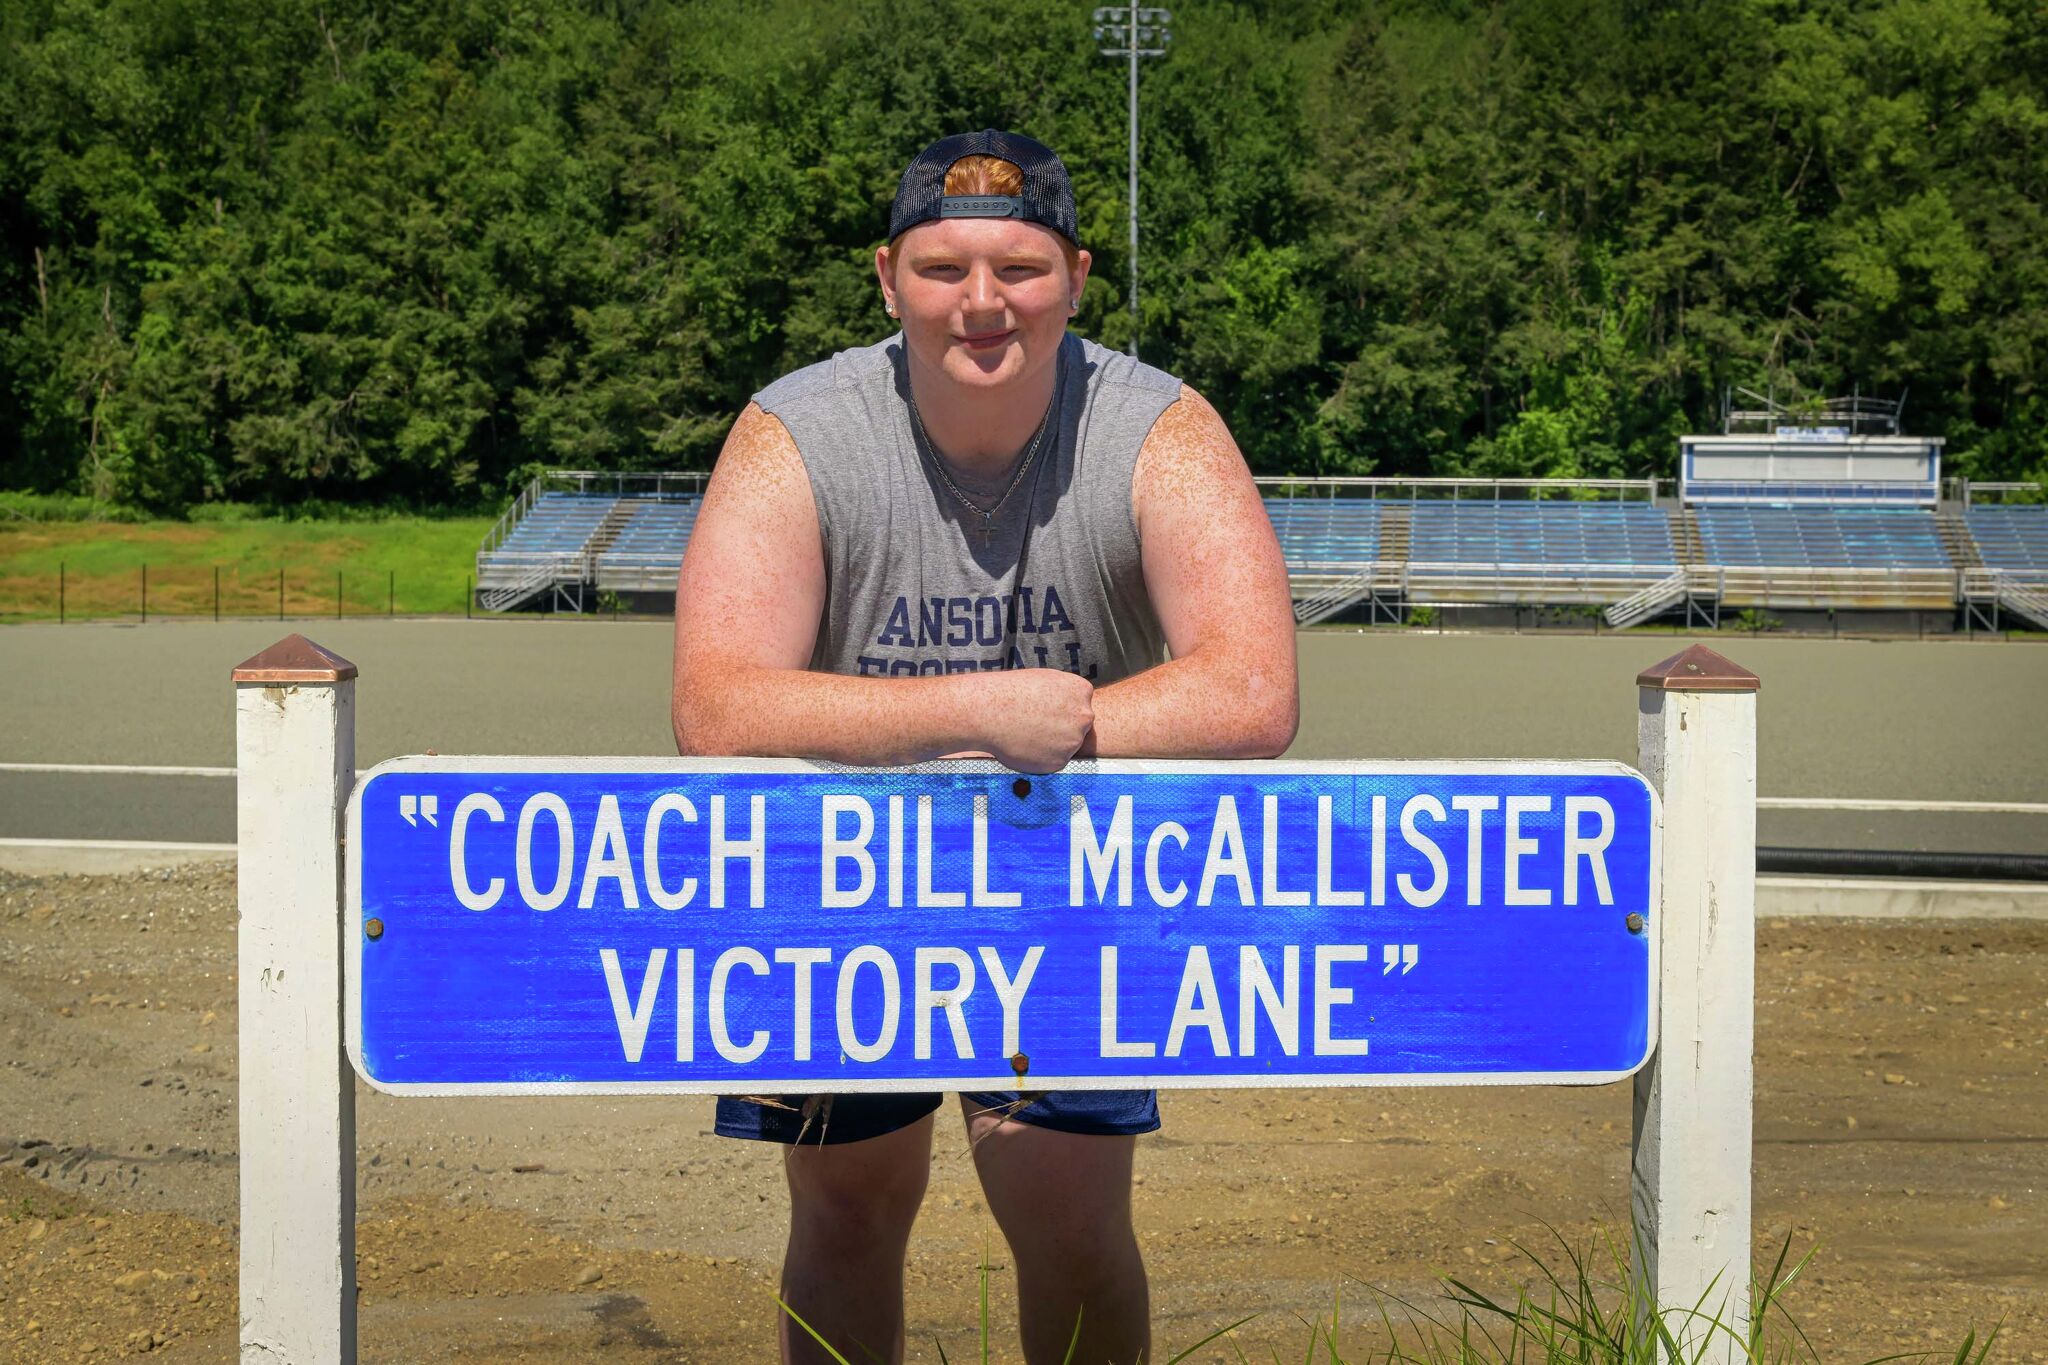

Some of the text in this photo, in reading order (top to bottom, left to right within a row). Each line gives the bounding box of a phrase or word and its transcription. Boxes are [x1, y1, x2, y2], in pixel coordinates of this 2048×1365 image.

[821, 794, 1022, 908] BILL
[1069, 794, 1616, 908] McALLISTER
[599, 944, 1045, 1064] VICTORY
